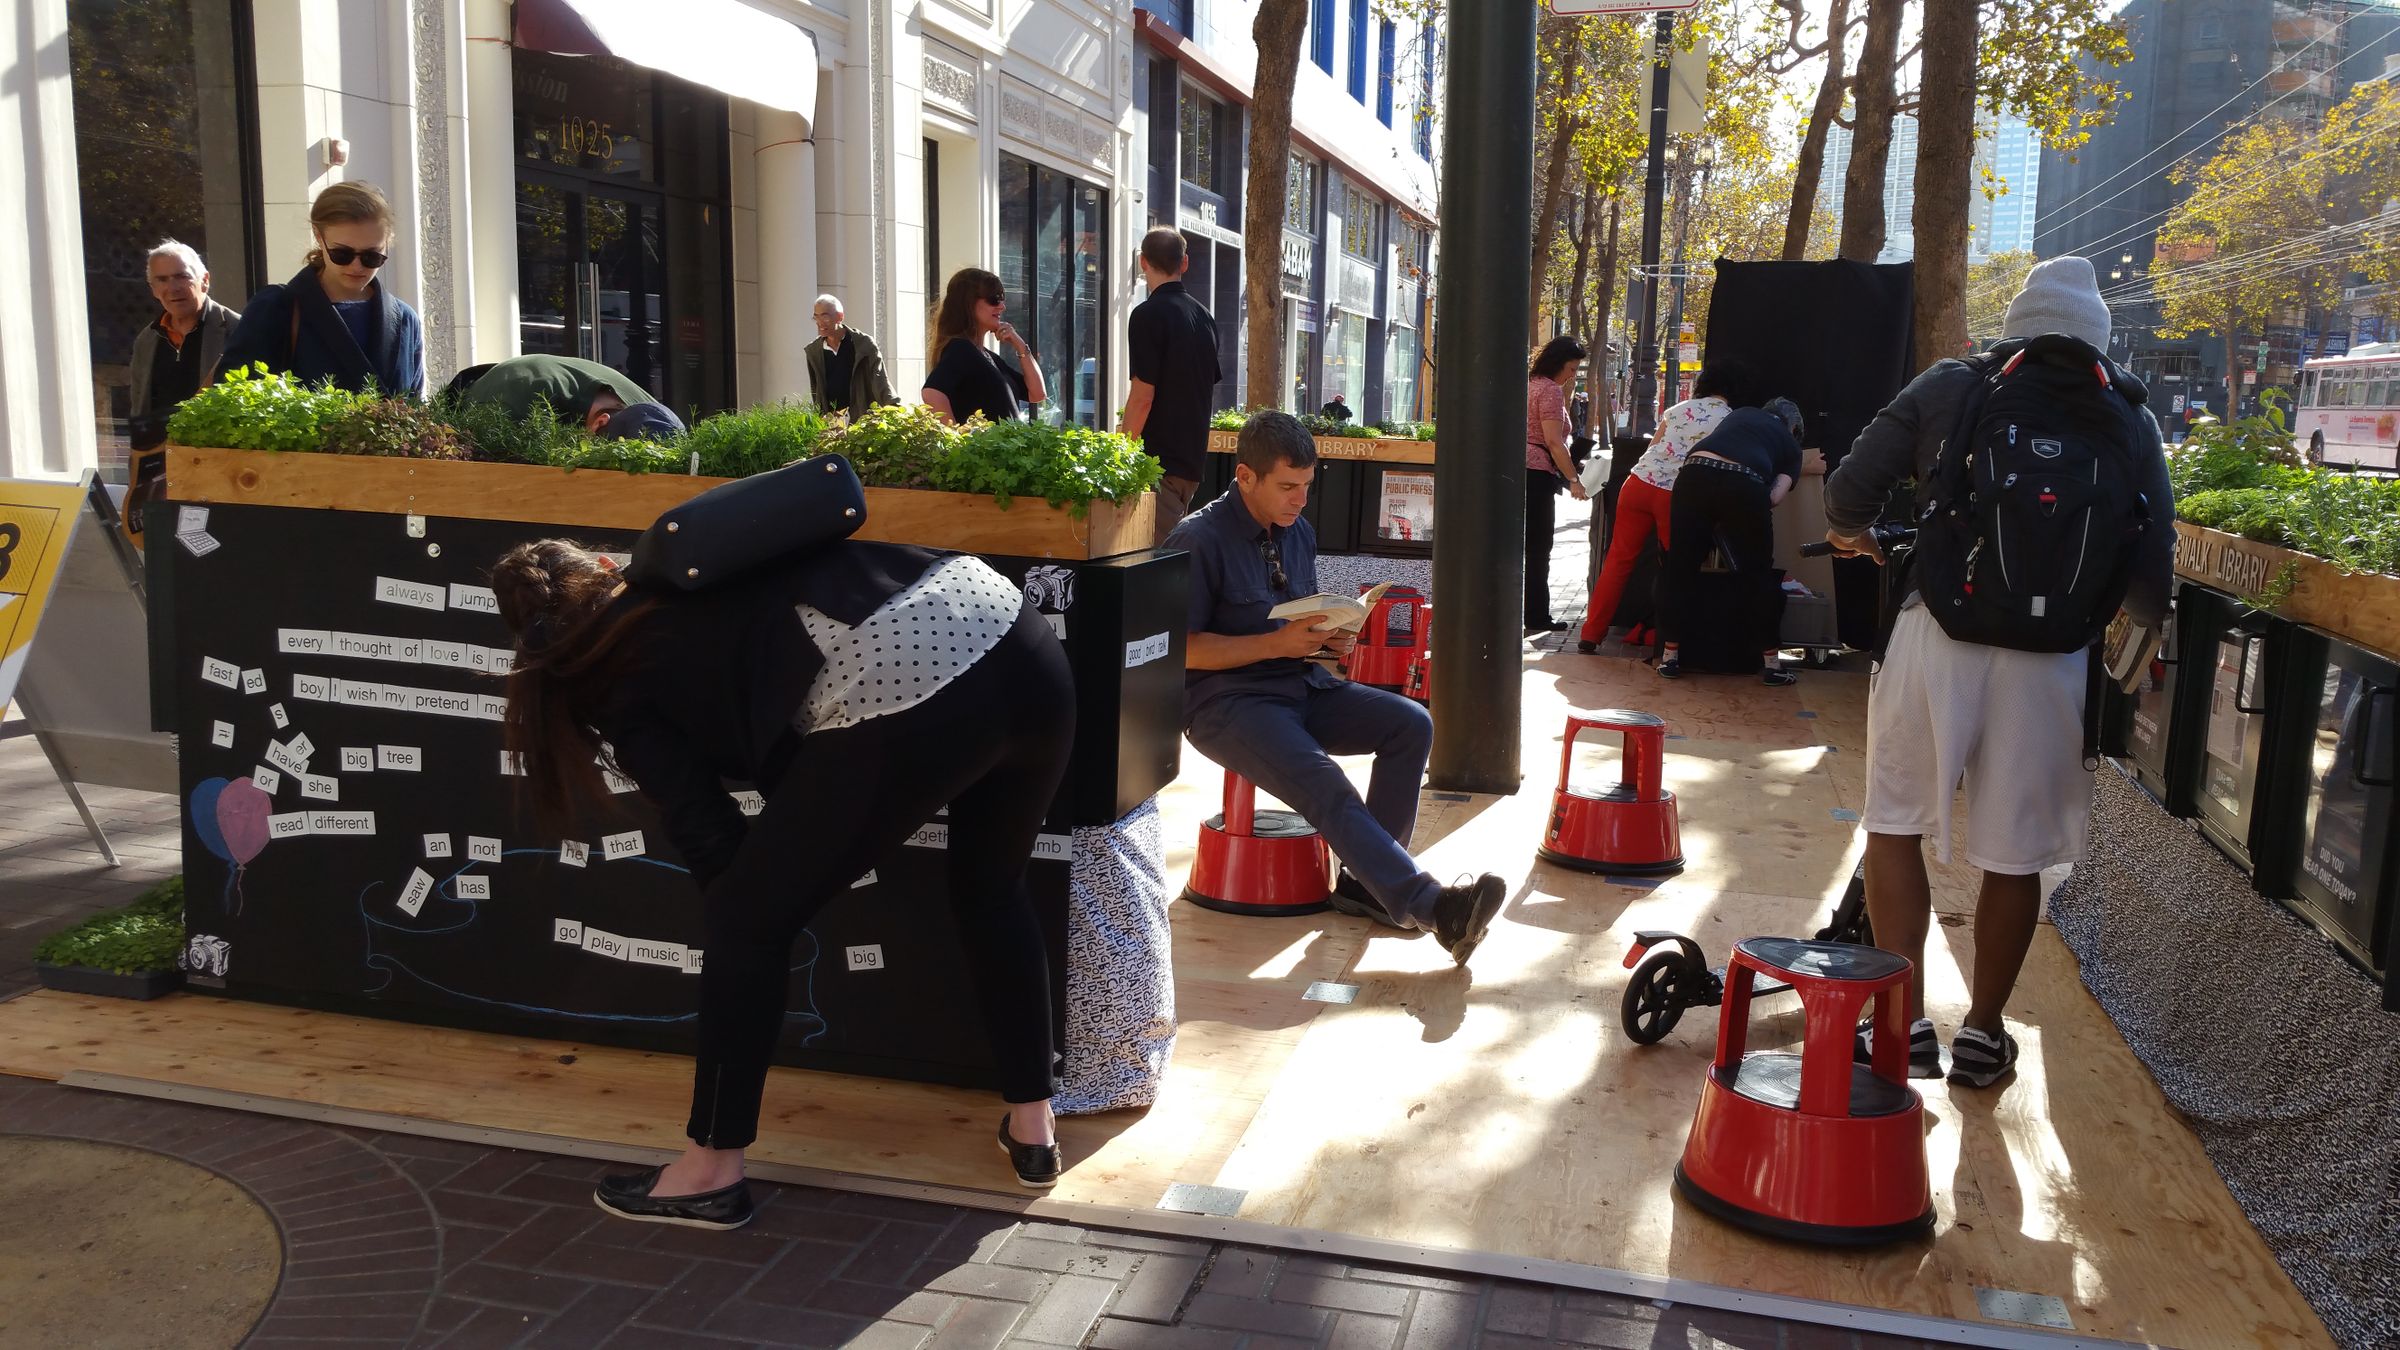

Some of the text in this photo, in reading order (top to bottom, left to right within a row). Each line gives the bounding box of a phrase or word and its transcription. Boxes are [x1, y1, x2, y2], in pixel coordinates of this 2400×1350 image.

[559, 114, 614, 161] 1025
[1214, 434, 1377, 456] SID IBRARY
[1385, 482, 1433, 496] PUBLIC PRESS
[2174, 533, 2269, 594] EWALK LIBRARY
[386, 583, 434, 605] always
[459, 590, 496, 610] jump
[287, 636, 516, 670] every thought of love is ma
[1128, 645, 1142, 664] good
[209, 663, 234, 682] fast
[246, 674, 263, 689] ed
[300, 680, 507, 716] boy I wish my pretend mo
[274, 709, 284, 720] s
[295, 741, 308, 756] er
[272, 747, 303, 774] have
[346, 752, 368, 769] big
[386, 750, 414, 765] tree
[259, 774, 274, 787] or
[308, 780, 333, 794] she
[275, 817, 304, 833] read
[314, 816, 369, 830] different
[429, 841, 447, 852] an
[473, 844, 496, 857] not
[566, 844, 584, 860] he
[609, 837, 639, 854] that
[1033, 839, 1062, 854] mb
[2320, 847, 2345, 873] DID YOU
[460, 880, 486, 894] has
[2303, 855, 2357, 904] READ ONE TODAY?
[407, 878, 426, 906] saw
[559, 926, 704, 967] go play music lit
[853, 950, 877, 966] big
